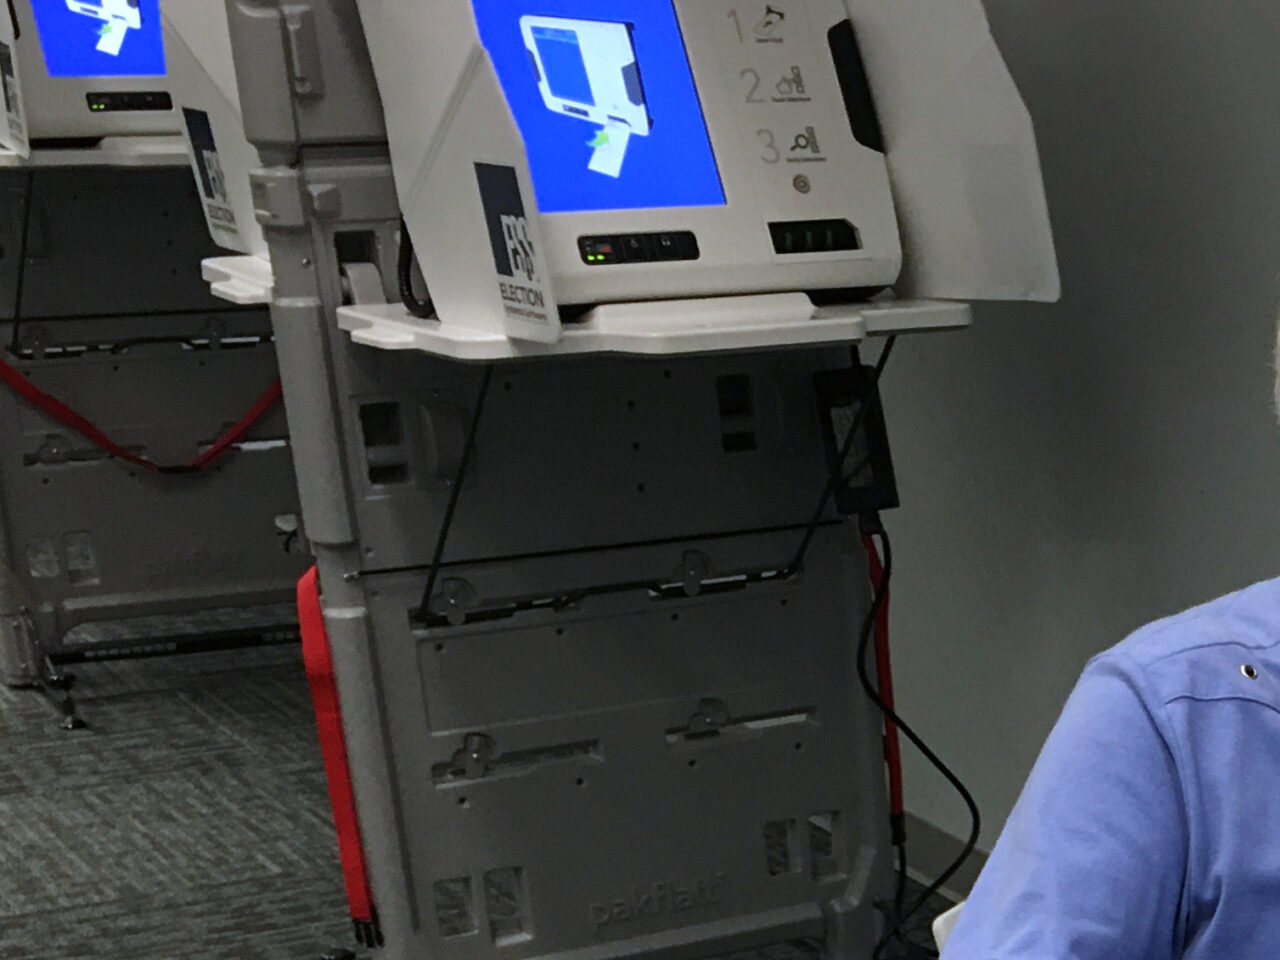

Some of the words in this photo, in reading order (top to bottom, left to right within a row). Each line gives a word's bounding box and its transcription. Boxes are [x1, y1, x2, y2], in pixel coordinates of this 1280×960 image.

[727, 8, 744, 44] 1
[740, 68, 766, 104] 2
[756, 128, 781, 165] 3
[500, 282, 546, 308] ELECTION
